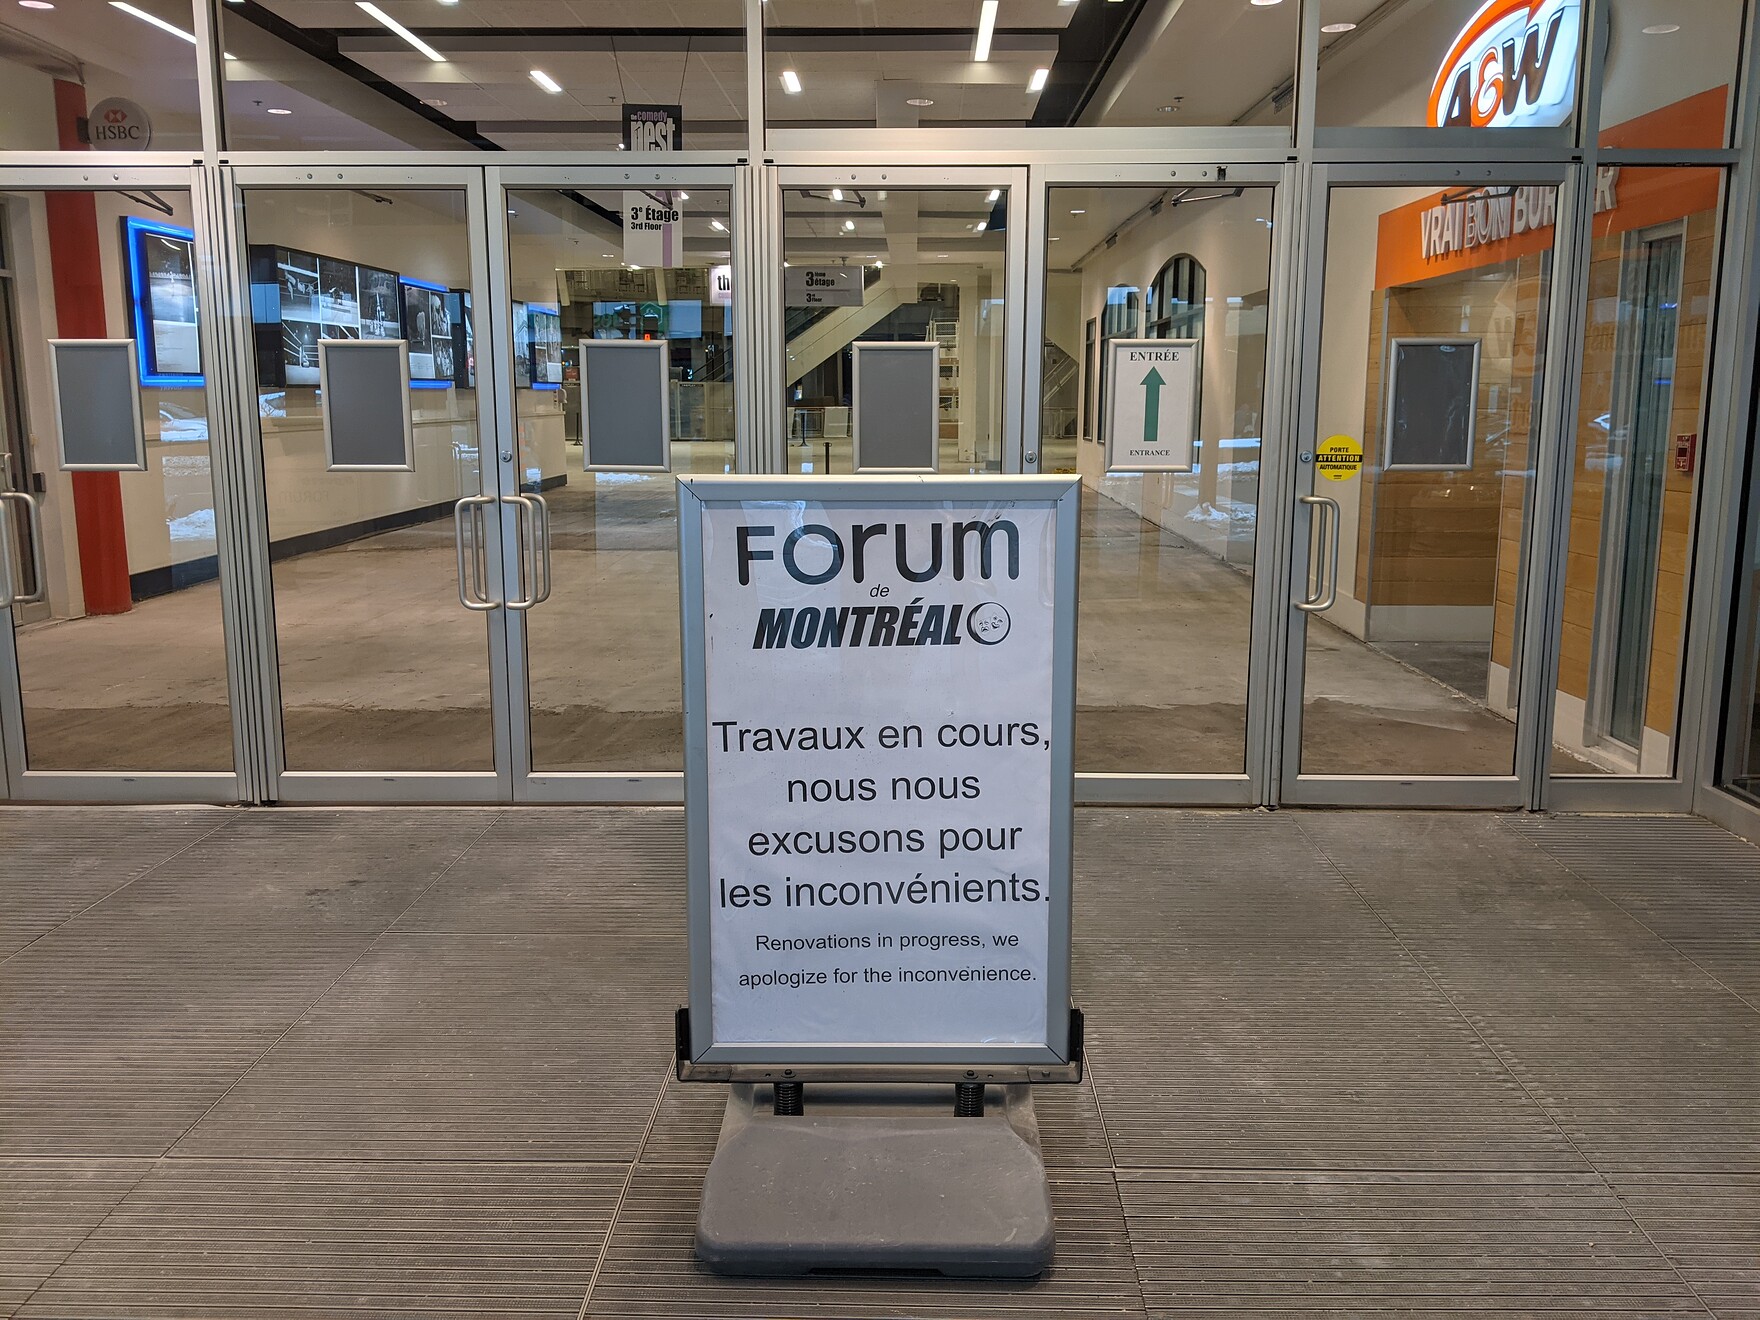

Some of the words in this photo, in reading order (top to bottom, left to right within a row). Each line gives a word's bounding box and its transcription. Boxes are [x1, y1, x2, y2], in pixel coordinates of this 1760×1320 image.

[1442, 6, 1565, 127] A&W
[637, 110, 667, 122] comedy
[95, 125, 140, 140] HSBC
[630, 117, 675, 151] nest
[645, 205, 679, 222] Étage
[1421, 202, 1464, 259] VRAI
[1464, 186, 1512, 249] BON
[631, 222, 643, 230] 3rd
[644, 222, 662, 231] Floor
[1129, 349, 1180, 362] ENTRÉE
[1129, 449, 1171, 457] ENTRANCE
[1318, 454, 1360, 462] ATTENTION
[869, 584, 890, 598] de
[752, 597, 964, 650] MONTRÉAL
[712, 721, 865, 752] Travaux
[878, 724, 922, 749] en
[936, 721, 1051, 751] cours,
[787, 777, 877, 802] nous
[892, 775, 981, 800] nous
[748, 827, 925, 856] excusons
[939, 826, 1022, 859] pour
[720, 878, 772, 908] les
[785, 872, 1051, 907] inconvénients.
[755, 934, 871, 951] Renovations
[876, 932, 893, 948] in
[899, 931, 986, 951] progress,
[991, 933, 1019, 948] we
[738, 969, 827, 989] apologize
[832, 967, 858, 985] for
[863, 966, 893, 984] the
[898, 964, 1037, 984] inconvenience.
